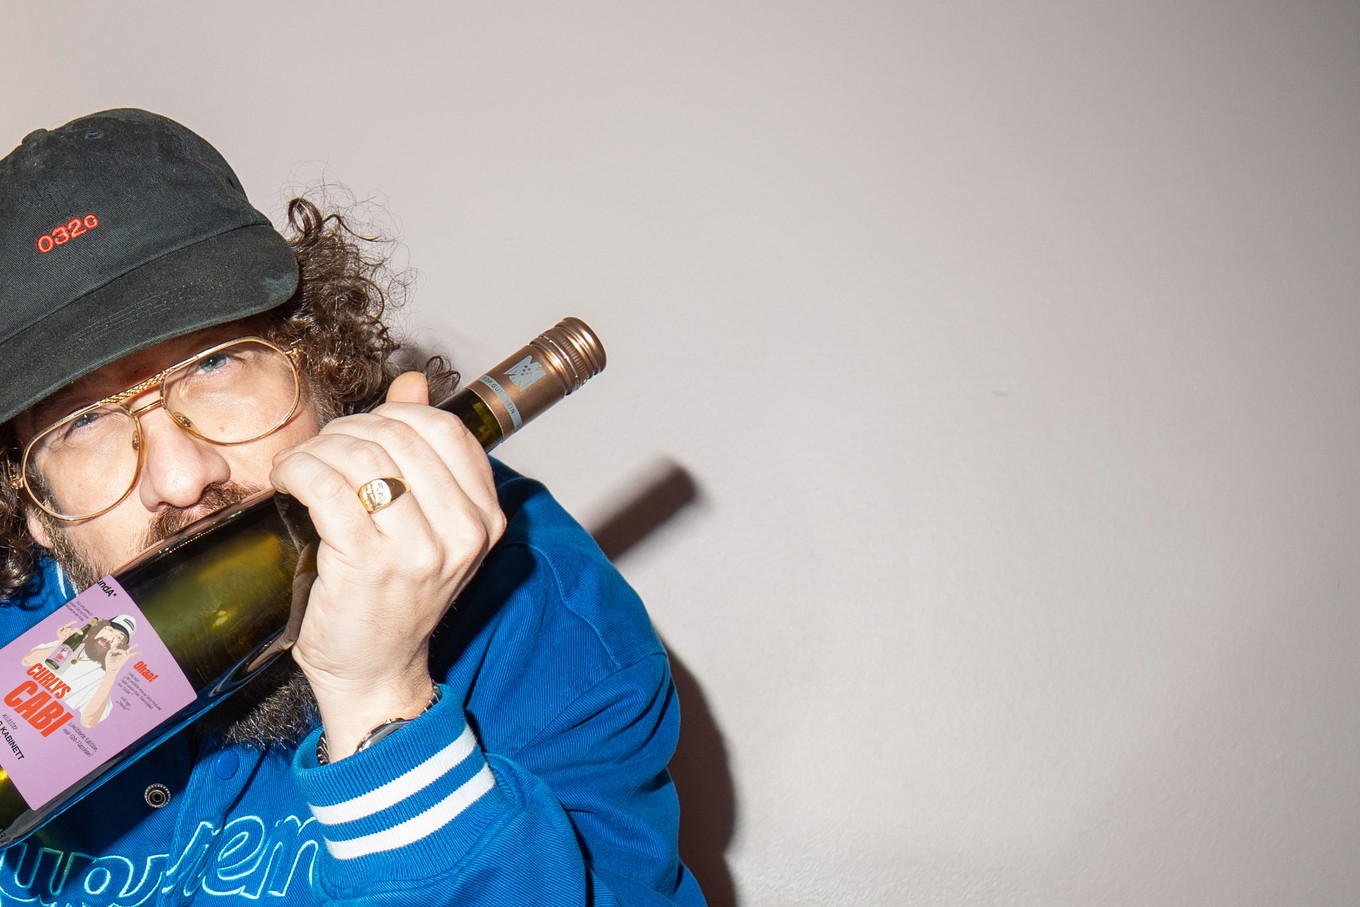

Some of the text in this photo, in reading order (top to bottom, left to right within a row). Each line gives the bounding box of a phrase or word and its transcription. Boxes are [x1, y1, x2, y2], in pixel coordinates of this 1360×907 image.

[26, 663, 71, 699] CURLYS
[133, 661, 159, 683] Ohaa!
[4, 680, 74, 738] CABI
[0, 726, 25, 760] KABINETT
